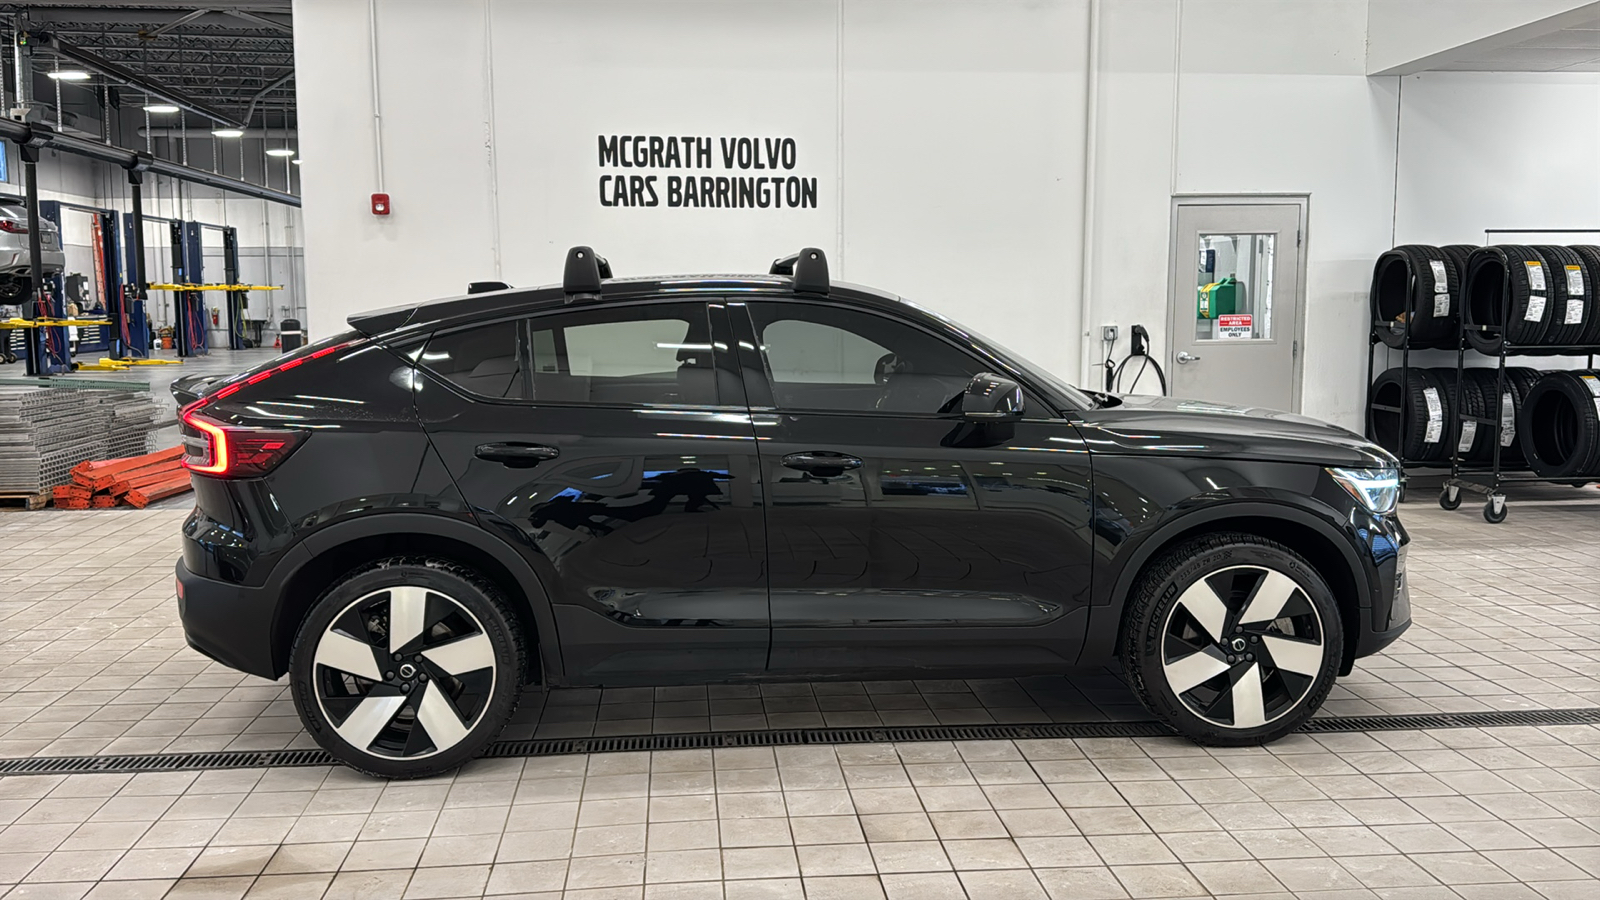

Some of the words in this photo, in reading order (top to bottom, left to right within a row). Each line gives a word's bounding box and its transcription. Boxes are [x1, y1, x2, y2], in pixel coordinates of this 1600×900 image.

[598, 135, 712, 169] MCGRATH
[720, 137, 796, 170] VOLVO
[599, 175, 659, 207] CARS
[667, 176, 817, 208] BARRINGTON
[1148, 584, 1176, 638] MICHELIN
